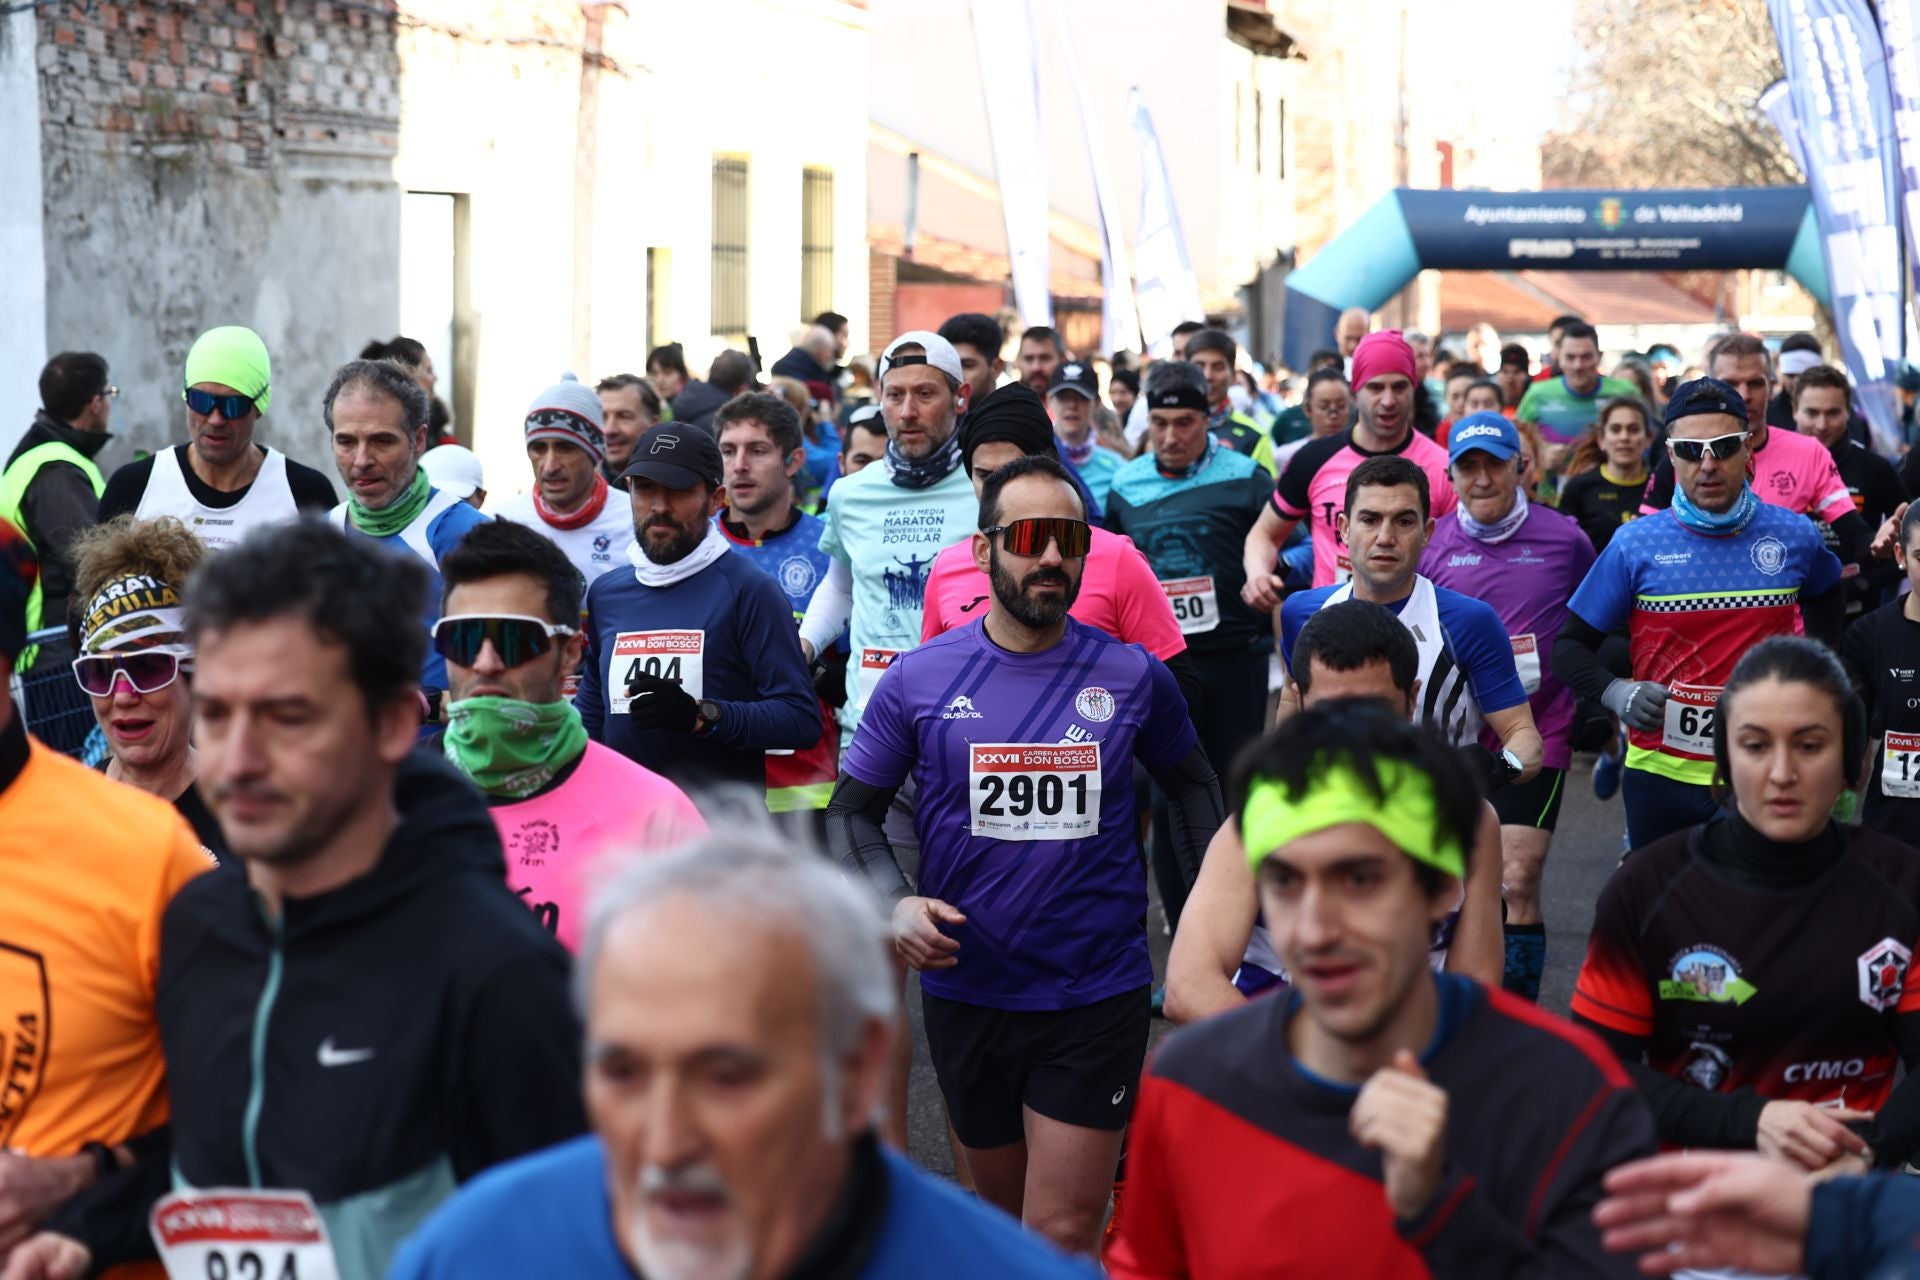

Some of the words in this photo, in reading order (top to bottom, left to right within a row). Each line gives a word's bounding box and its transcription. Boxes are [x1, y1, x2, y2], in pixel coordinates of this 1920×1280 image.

[1456, 424, 1503, 442] adidas
[883, 533, 941, 545] POPULAR
[1448, 553, 1482, 567] Javier
[1173, 595, 1204, 620] 50
[617, 640, 646, 649] XXVII
[647, 641, 665, 649] DON
[666, 640, 700, 648] BOSCO
[1672, 687, 1701, 701] XXVII
[943, 711, 983, 720] austral
[1888, 737, 1912, 746] XXVII
[976, 753, 1020, 764] XXVII
[1024, 755, 1051, 765] DON
[1053, 755, 1096, 765] BOSCO
[1023, 749, 1058, 757] CARRERA
[979, 773, 1087, 817] 2901
